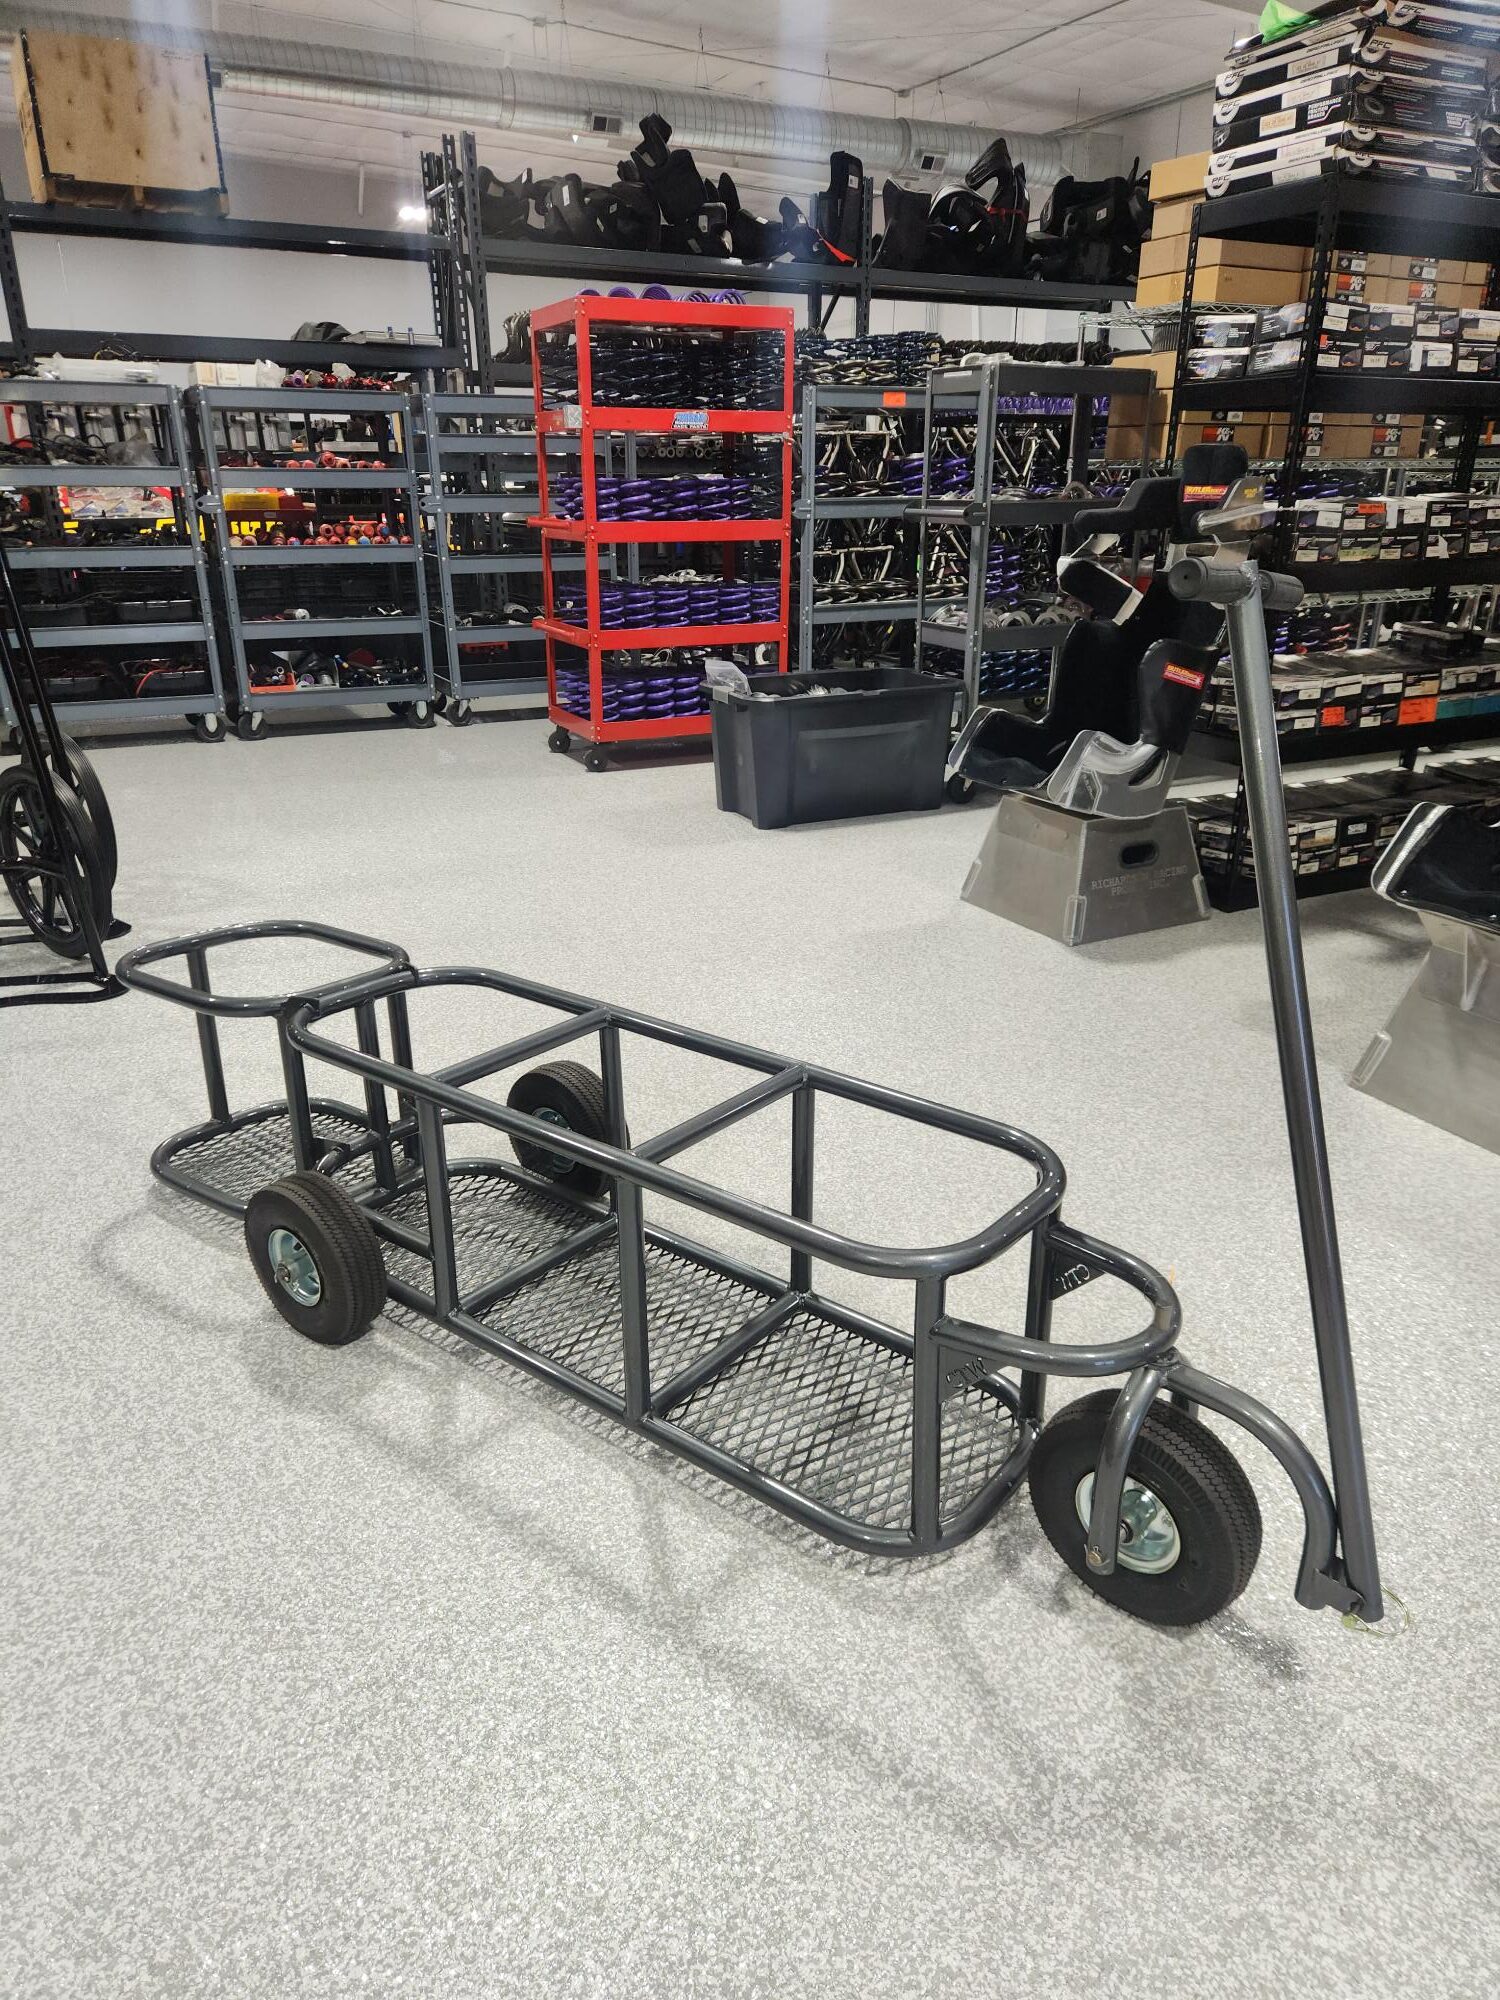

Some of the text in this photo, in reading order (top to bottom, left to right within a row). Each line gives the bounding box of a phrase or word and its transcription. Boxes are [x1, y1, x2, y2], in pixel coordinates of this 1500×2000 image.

[1400, 4, 1426, 14] PFC
[1369, 39, 1393, 50] PFC
[1225, 69, 1247, 80] PFC
[1217, 151, 1238, 161] PFC
[1212, 173, 1231, 183] PFC
[1091, 872, 1149, 889] RICHAR
